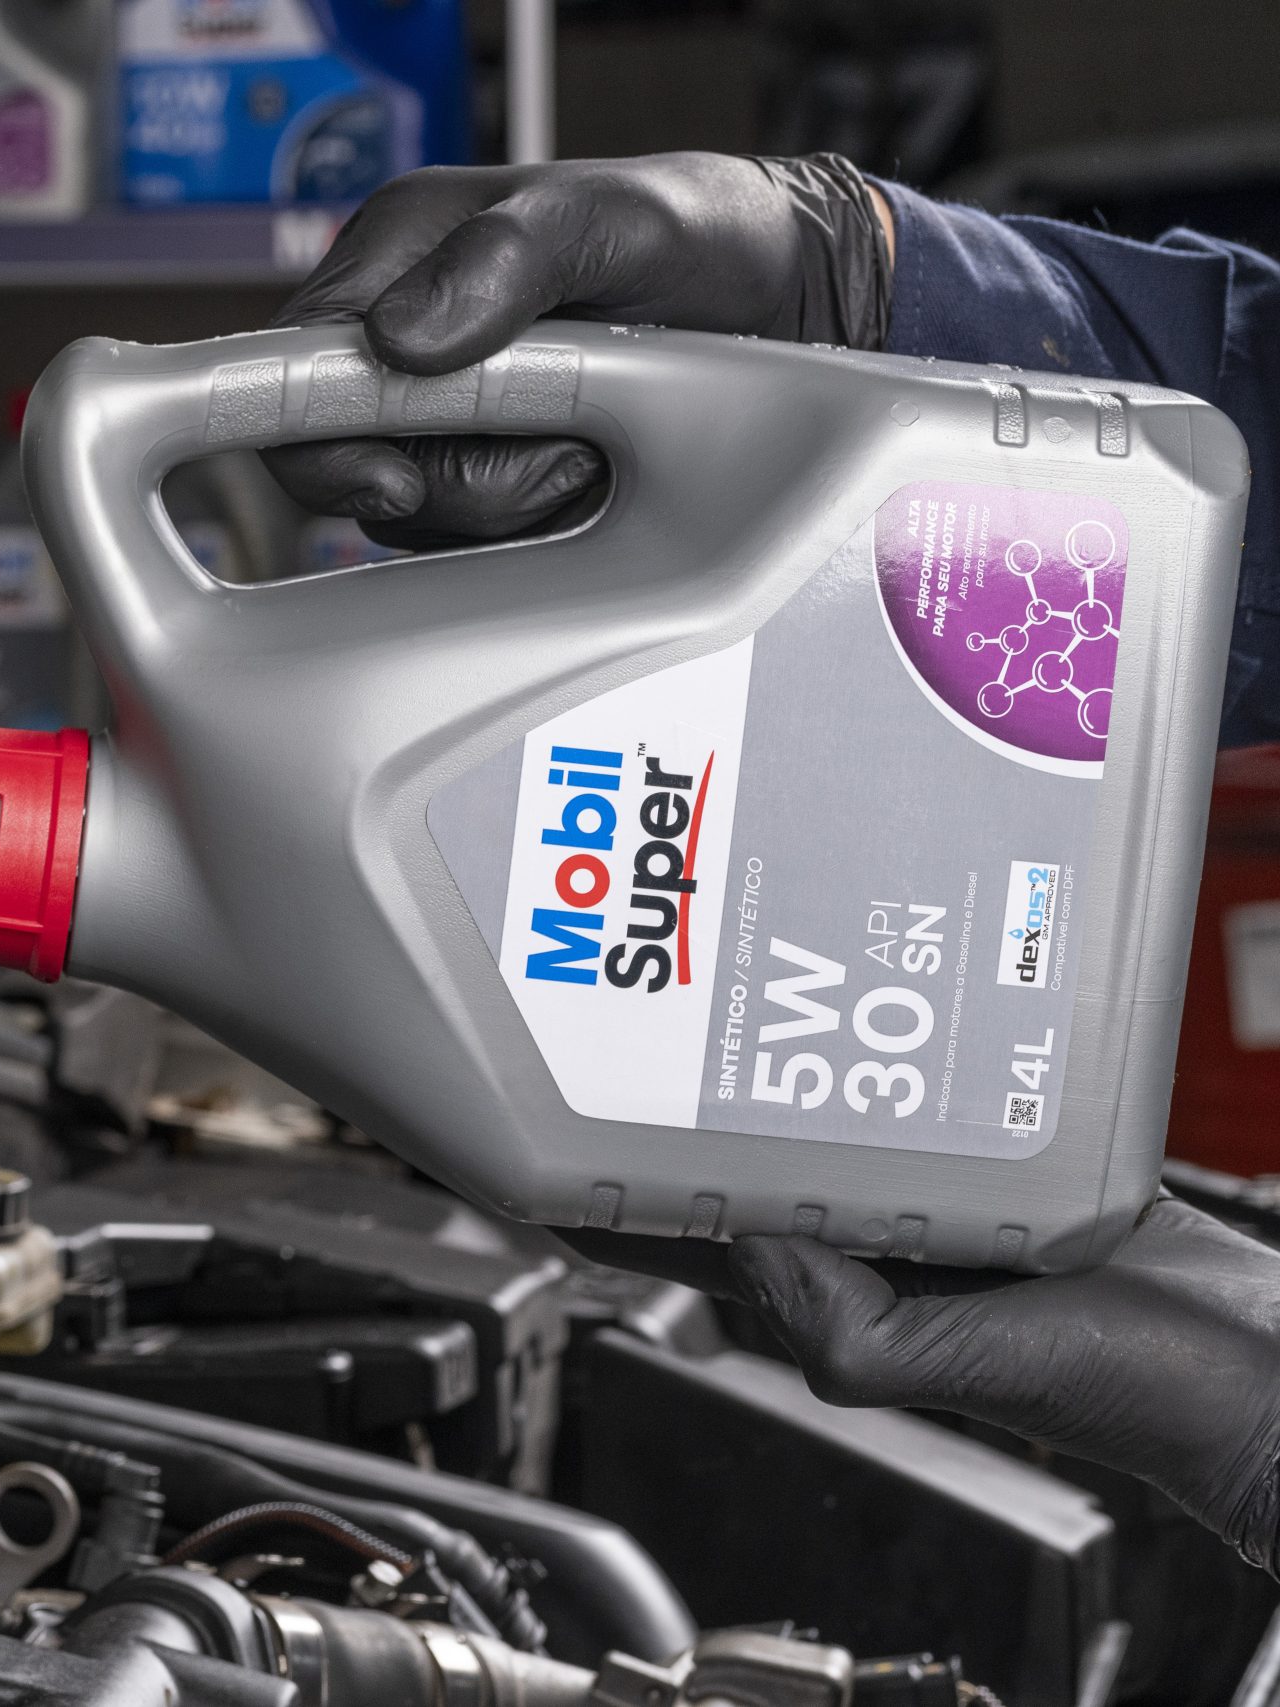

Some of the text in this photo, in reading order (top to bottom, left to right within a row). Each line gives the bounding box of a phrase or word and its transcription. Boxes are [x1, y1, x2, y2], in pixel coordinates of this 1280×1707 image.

[907, 500, 921, 538] ALTA
[916, 500, 939, 619] PERFORMANCE
[932, 502, 957, 637] PARA SEU MOTOR
[958, 504, 976, 600] Alto rendimiento
[976, 504, 990, 588] para su motor
[526, 746, 623, 985] Mobil
[1042, 870, 1056, 940] GM APPROVED
[718, 984, 748, 1100] SINTÉTICO
[736, 857, 762, 967] SINTÉTICO
[865, 901, 901, 969] API
[902, 904, 946, 976] SN
[1051, 864, 1075, 991] Compatível com DPF
[751, 936, 846, 1110] 5W
[844, 986, 934, 1118] 30
[936, 871, 977, 1122] Indicado para motores a Gasolina e Diesel
[1011, 1028, 1054, 1090] 4L
